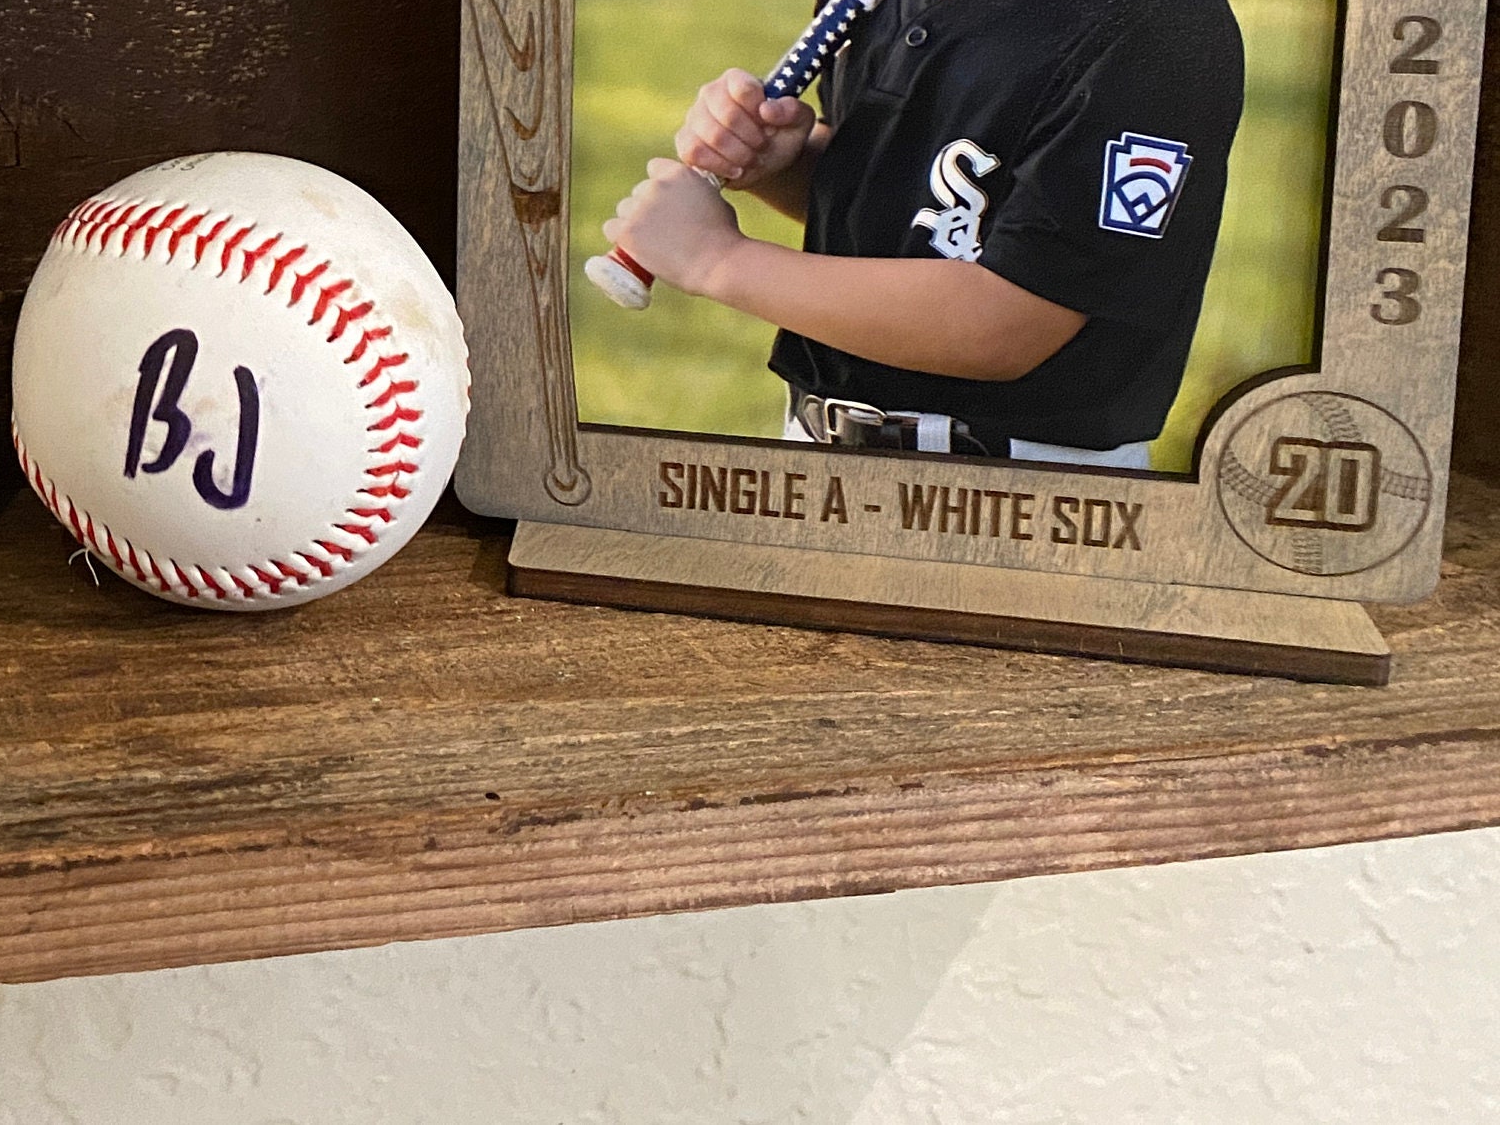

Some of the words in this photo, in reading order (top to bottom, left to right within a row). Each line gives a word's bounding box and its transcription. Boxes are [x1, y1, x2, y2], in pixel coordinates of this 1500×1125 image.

[1369, 15, 1445, 327] 2023
[123, 328, 260, 510] BJ
[1265, 436, 1382, 533] 20
[658, 461, 807, 521] SINGLE
[819, 475, 850, 524] A
[863, 504, 882, 513] -
[898, 481, 1036, 541] WHITE
[1050, 495, 1143, 551] SOX
